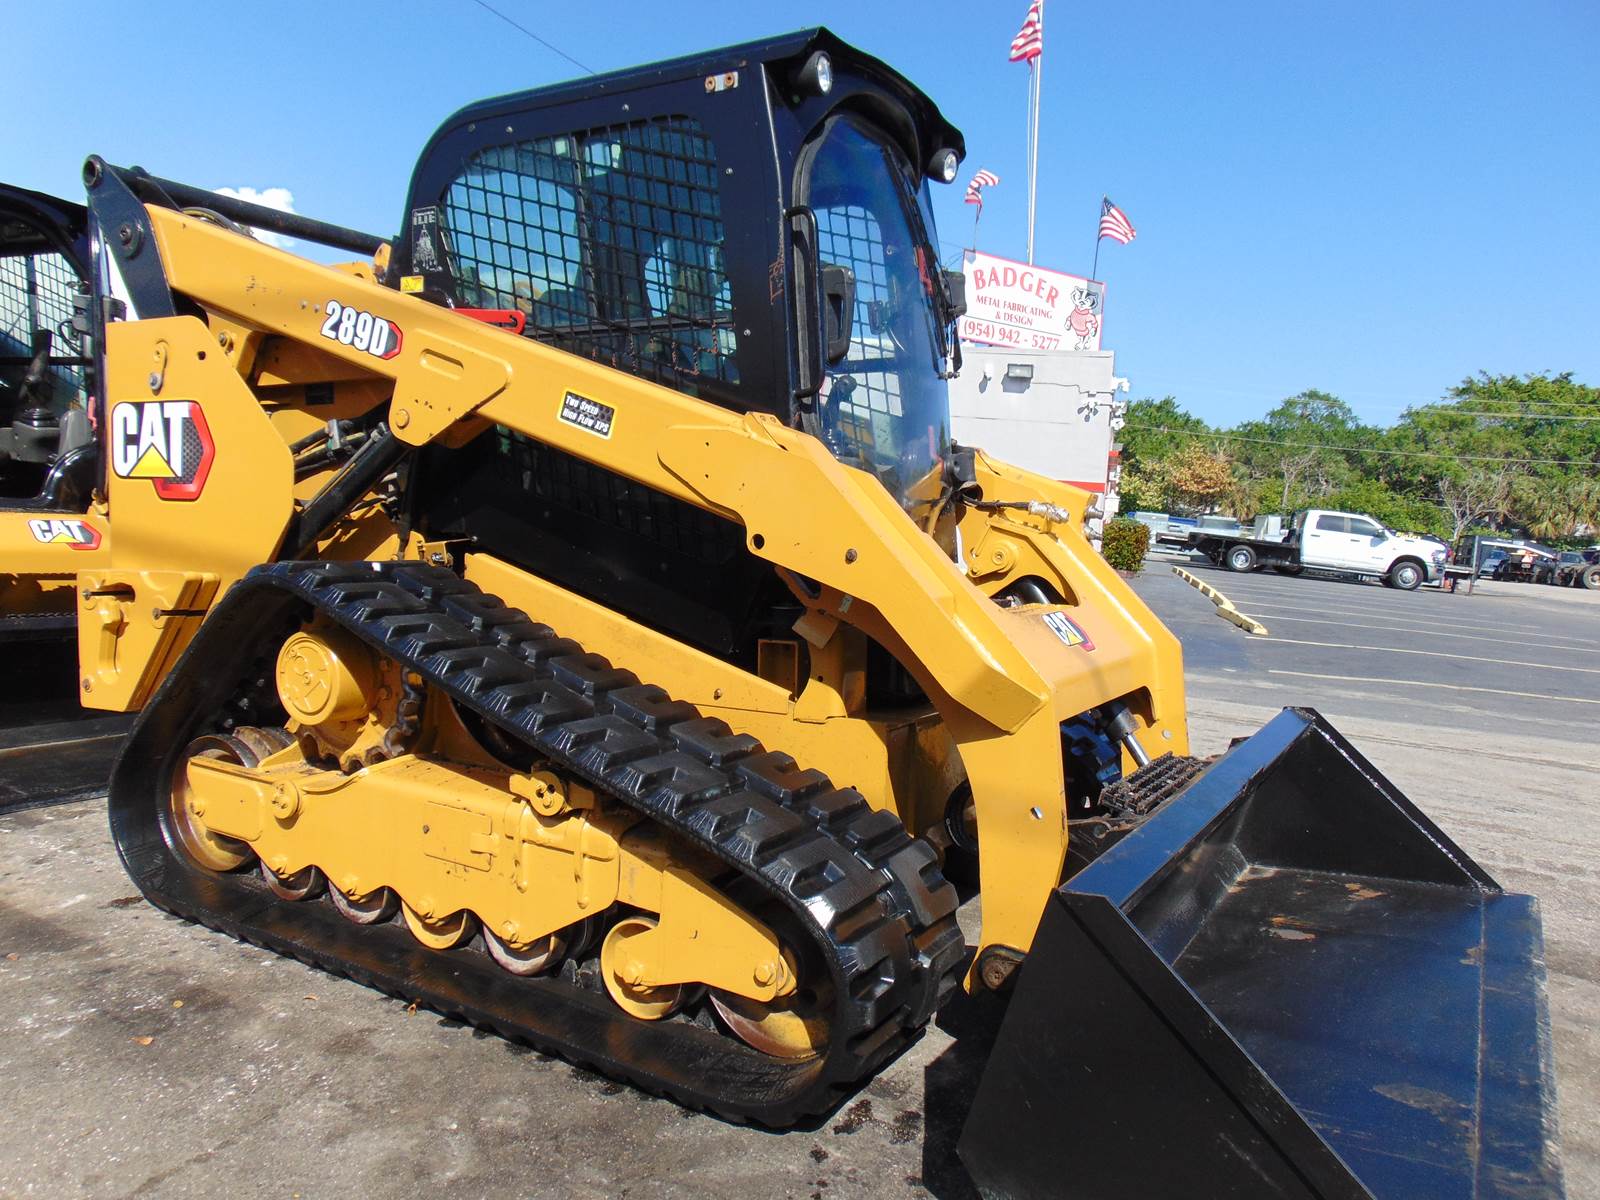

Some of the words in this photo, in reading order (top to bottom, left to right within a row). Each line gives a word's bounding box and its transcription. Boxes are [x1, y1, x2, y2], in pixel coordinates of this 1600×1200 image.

[973, 267, 1059, 308] BADGER
[976, 294, 1000, 308] METAL
[1003, 300, 1053, 319] FABRICATING
[995, 311, 1001, 320] &
[1003, 313, 1033, 327] DESIGN
[320, 299, 389, 357] 289D
[964, 319, 995, 340] (954)
[998, 327, 1020, 345] 942
[1031, 335, 1060, 350] 5277
[580, 401, 599, 416] SPEED
[112, 401, 190, 477] CAT
[28, 519, 85, 543] CAT
[1042, 611, 1084, 646] CAT
